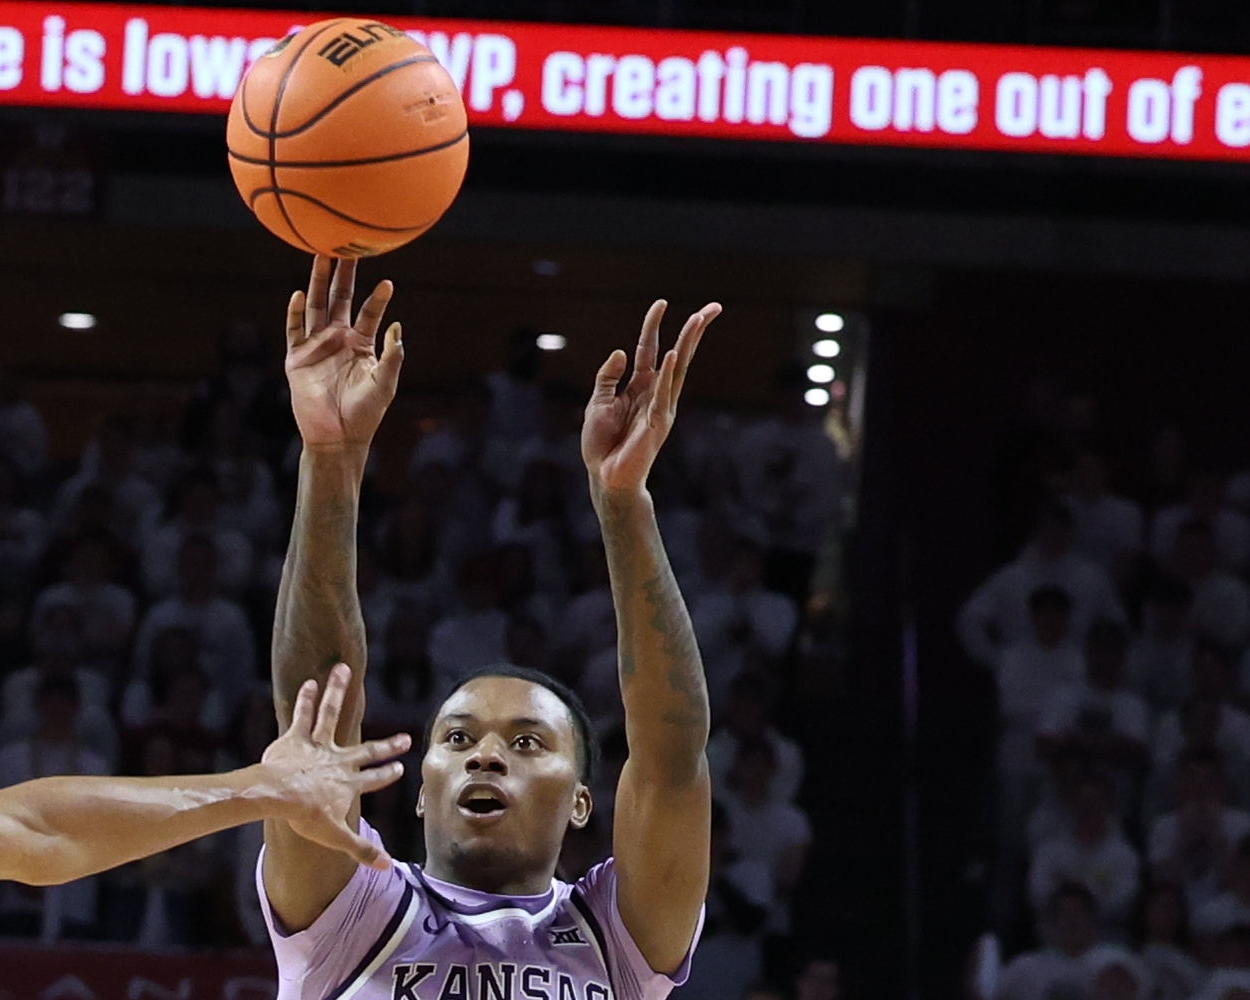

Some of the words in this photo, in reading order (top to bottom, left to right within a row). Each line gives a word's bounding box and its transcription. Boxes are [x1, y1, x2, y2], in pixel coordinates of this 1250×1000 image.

[41, 16, 106, 92] is
[405, 28, 524, 120] VP,
[542, 47, 834, 137] creating
[850, 66, 978, 134] one
[996, 68, 1112, 140] out
[1127, 66, 1203, 143] of
